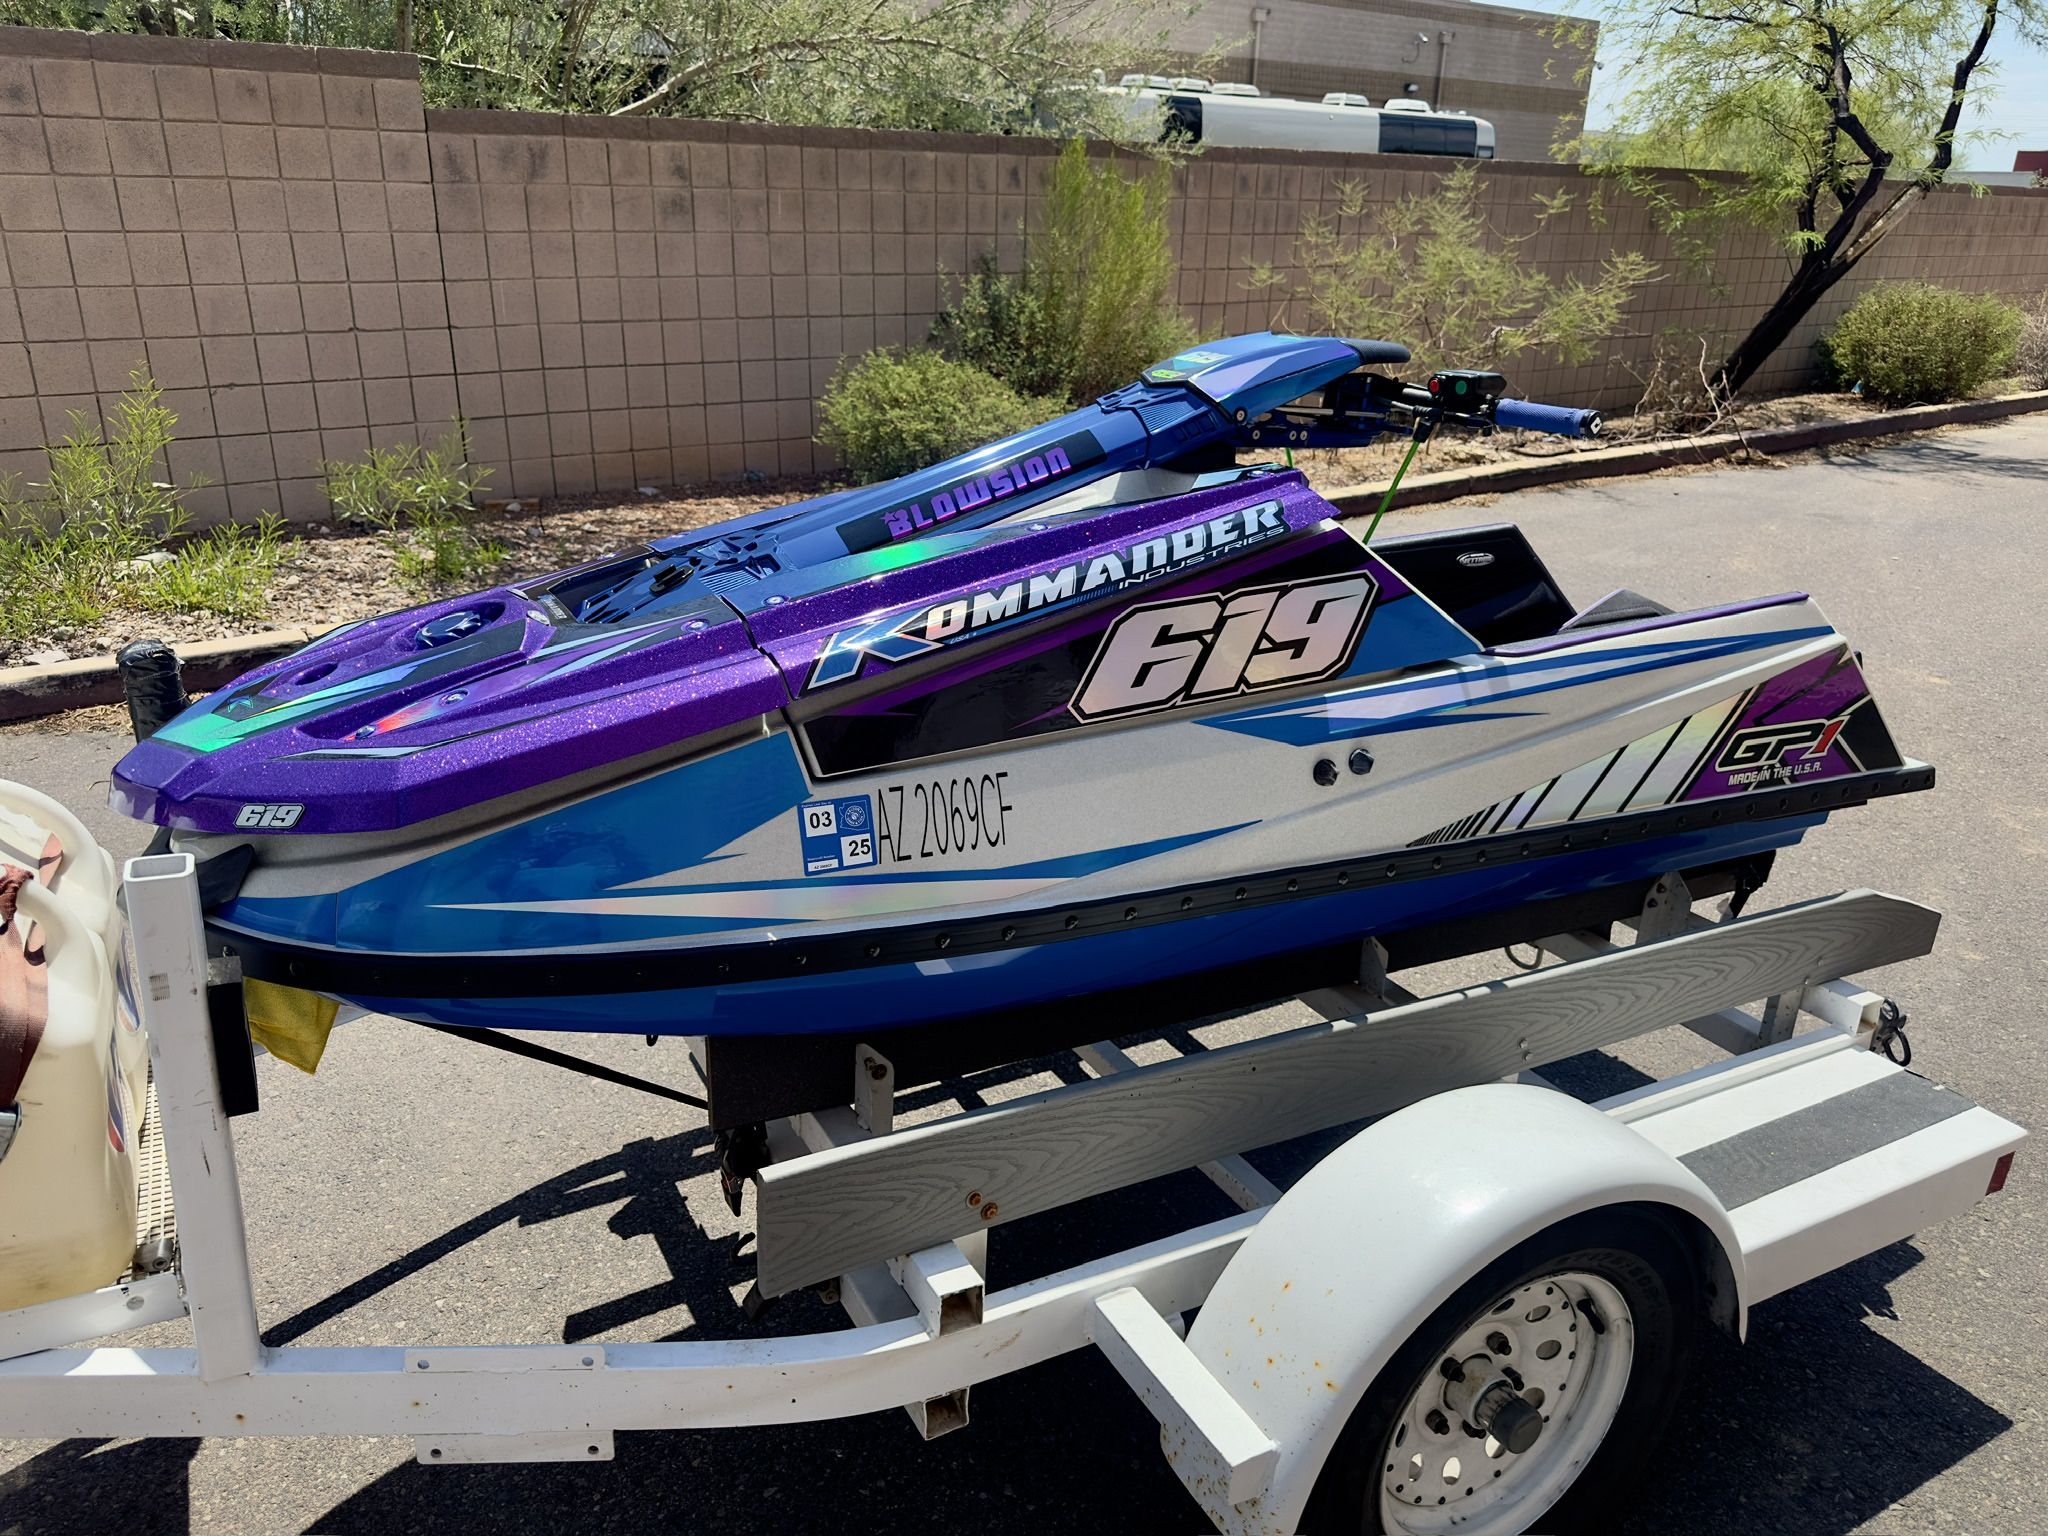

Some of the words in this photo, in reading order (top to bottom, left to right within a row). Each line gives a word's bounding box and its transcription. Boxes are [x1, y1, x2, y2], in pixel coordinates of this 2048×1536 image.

[880, 446, 1072, 541] BLOWSION
[1118, 526, 1284, 590] INDUSTRIES
[808, 501, 1282, 689] KOMMANDER
[1074, 574, 1375, 719] 619
[1716, 716, 1849, 771] GP1
[1728, 771, 1759, 786] MADE
[1759, 769, 1771, 781] IN
[1774, 766, 1792, 778] THE
[1794, 762, 1822, 775] U.S.A.
[235, 805, 303, 827] 619
[809, 810, 833, 829] 03
[878, 785, 912, 864] AZ
[914, 771, 1013, 859] 2069CF
[848, 838, 871, 857] 25
